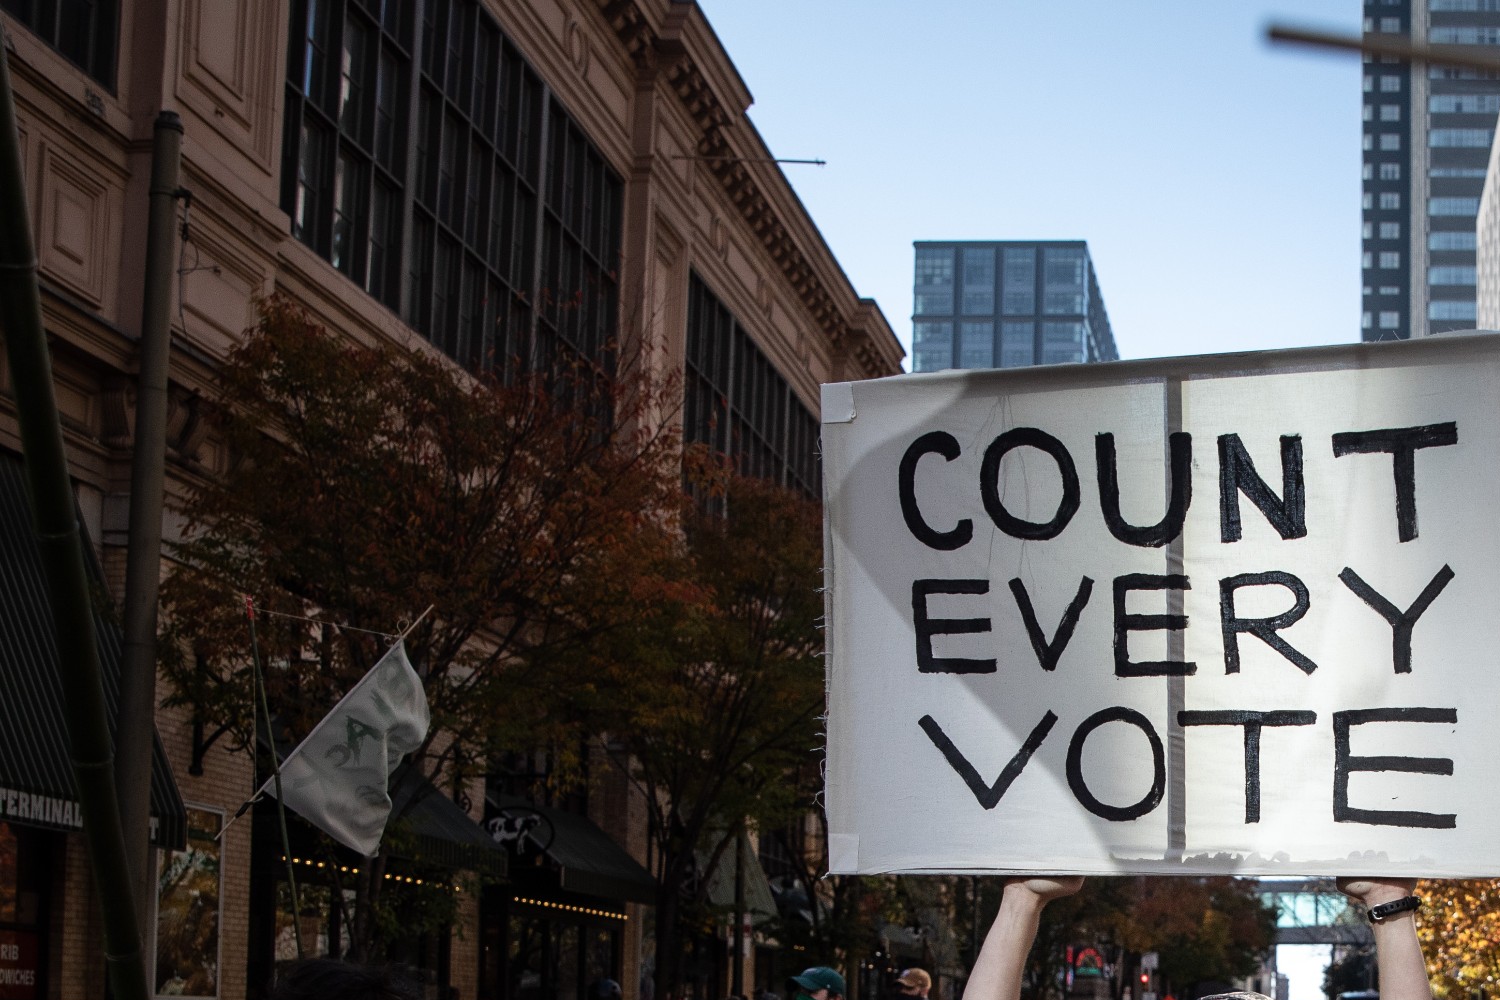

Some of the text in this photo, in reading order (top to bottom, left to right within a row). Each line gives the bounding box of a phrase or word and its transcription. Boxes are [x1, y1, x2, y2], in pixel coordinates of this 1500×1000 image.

[899, 421, 1458, 551] COUNT
[911, 564, 1455, 678] EVERY
[918, 705, 1458, 828] VOTE
[1, 944, 19, 960] RIB
